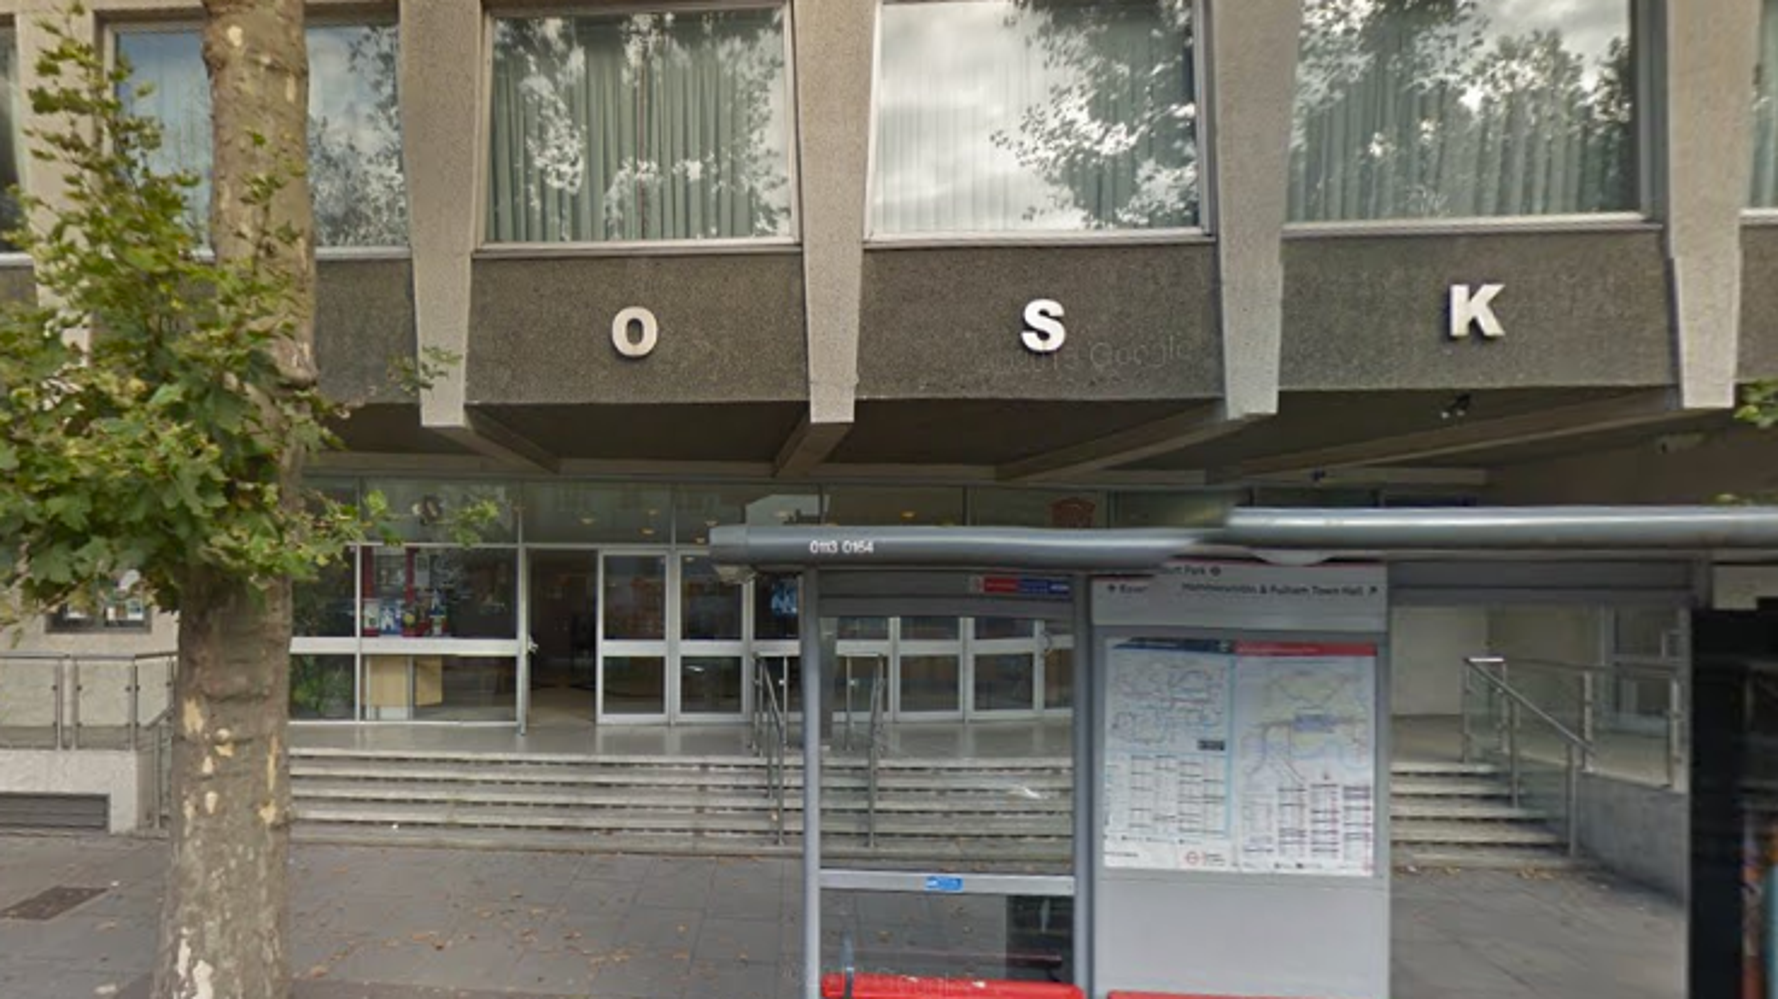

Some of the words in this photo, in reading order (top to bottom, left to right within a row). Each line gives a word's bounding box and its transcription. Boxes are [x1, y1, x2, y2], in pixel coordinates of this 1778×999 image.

[612, 306, 658, 356] O
[1021, 299, 1066, 352] S
[1449, 283, 1505, 336] K
